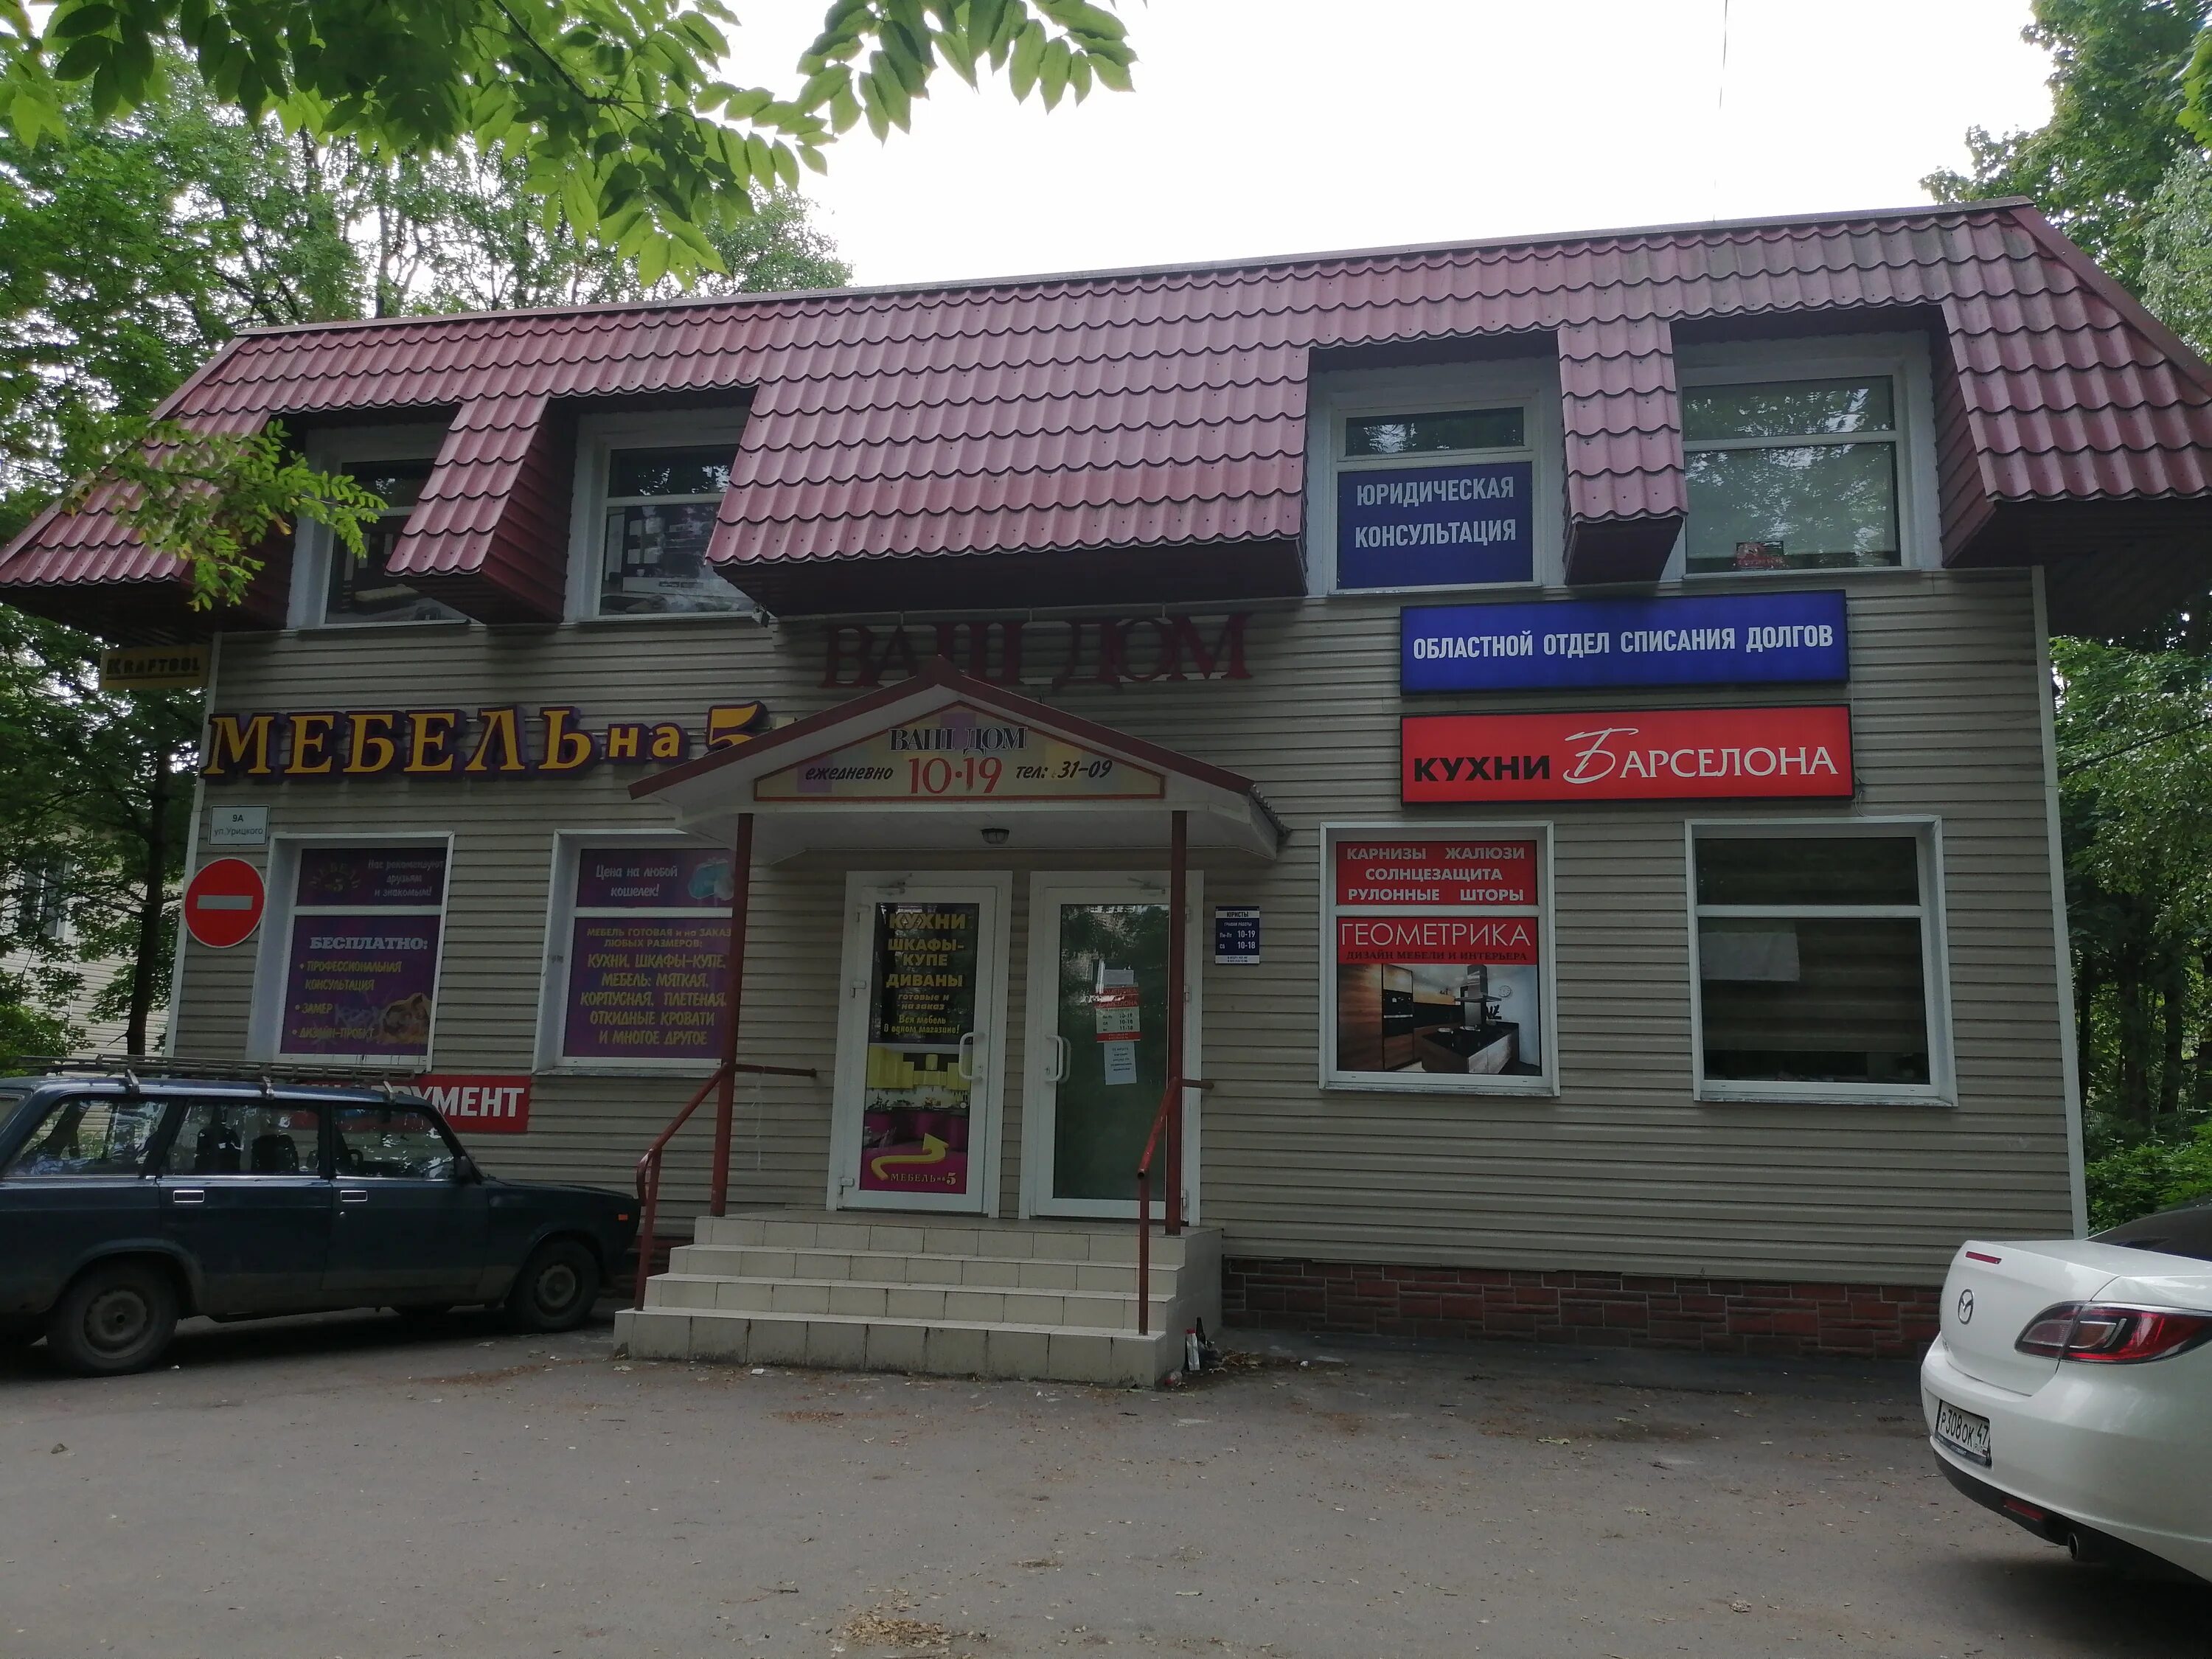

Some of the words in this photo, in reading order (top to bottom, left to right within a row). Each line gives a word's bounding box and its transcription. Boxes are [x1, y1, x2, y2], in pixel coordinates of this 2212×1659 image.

[1356, 476, 1514, 508] ЮРИДИЧЕСКАЯ
[1355, 519, 1516, 548] КОНСУЛЬТАЦИЯ
[1413, 630, 1534, 659] ОБЛАСТНОЙ
[1543, 632, 1610, 658] ОТДЕЛ
[1620, 627, 1736, 654] СПИСАНИЯ
[1746, 624, 1834, 653] ДОЛГОВ
[820, 622, 1026, 688] ВАШ
[1051, 613, 1253, 692] ДОМ
[105, 657, 200, 675] KRAFTOOL
[201, 708, 591, 774] МЕБЕЛЬ
[607, 723, 680, 758] на
[888, 727, 956, 751] ВАШ
[963, 726, 1028, 755] ДОМ
[1414, 755, 1550, 782] КУХНИ
[1562, 727, 1839, 786] БАРСЕЛОНА
[805, 765, 894, 781] ежедневно
[1016, 765, 1048, 779] тел:
[1057, 759, 1113, 779] 31-09
[232, 814, 244, 823] 9А
[226, 826, 263, 837] Урицкого
[1347, 848, 1426, 860] КАРНИЗЫ
[1445, 847, 1525, 860] ЖАЛЮЗИ
[596, 864, 622, 880] Цена
[627, 868, 640, 877] на
[644, 865, 678, 877] любой
[1366, 868, 1503, 882] СОЛНЦЕЗАЩИТА
[383, 886, 432, 897] знакомым!
[611, 884, 660, 897] кошелек!
[1348, 889, 1439, 901] РУЛОННЫЕ
[1460, 889, 1523, 901] ШТОРЫ
[889, 913, 966, 929] КУХНИ
[587, 928, 625, 937] МЕБЕЛЬ
[627, 928, 673, 937] ГОТОВАЯ
[699, 928, 731, 937] ЗАКАЗ
[1237, 930, 1256, 938] 10-19
[1341, 923, 1531, 946] ГЕОМЕТРИКА
[309, 936, 428, 950] БЕСПЛАТНО:
[604, 939, 644, 947] ЛЮБЫХ
[888, 939, 964, 951] ШКАФЫ-
[902, 953, 948, 966] КУПЕ
[1346, 949, 1394, 960] ДИЗАЙН
[1397, 951, 1444, 959] МЕБЕЛИ
[1462, 951, 1527, 961] ИНТЕРЬЕРА
[306, 961, 402, 973] ПРОФЕССИОНАЛЬНАЯ
[305, 979, 375, 991] КОНСУЛЬТАЦИЯ
[886, 973, 963, 987] ДИВАНЫ
[301, 1003, 333, 1015] ЗАМЕР
[590, 1011, 655, 1025] ОТКИДНЫЕ
[660, 1011, 714, 1026] КРОВАТИ
[599, 1030, 608, 1044] И
[612, 1030, 660, 1045] МНОГОЕ
[664, 1030, 708, 1046] ДРУГОЕ
[891, 1173, 936, 1183] МЕБЕЛЬ
[946, 1172, 956, 1186] 5
